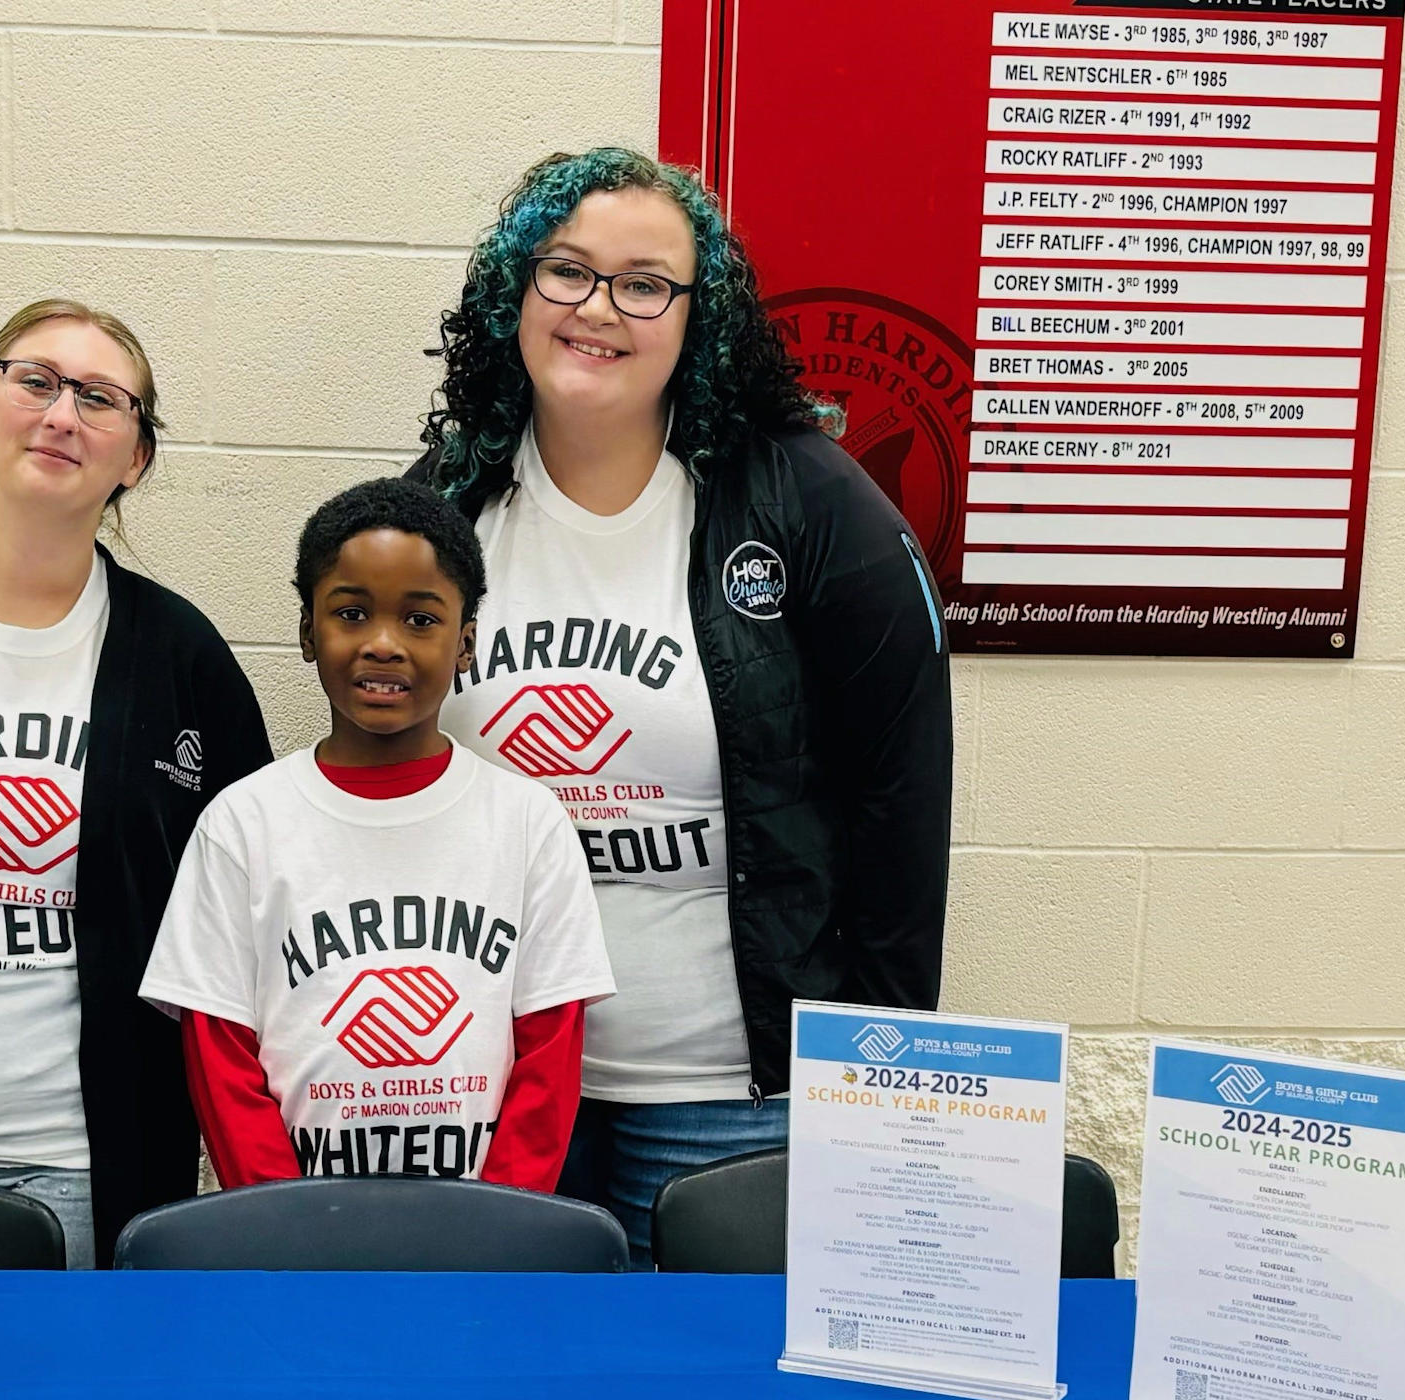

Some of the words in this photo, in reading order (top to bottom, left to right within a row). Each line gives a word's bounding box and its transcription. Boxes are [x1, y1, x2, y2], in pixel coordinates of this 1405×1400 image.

[1007, 21, 1049, 38] KYLE
[1055, 23, 1109, 40] MAYSE
[1124, 25, 1146, 41] 3RD
[1151, 26, 1189, 45] 1985,
[1195, 27, 1217, 43] 3RD
[1223, 29, 1260, 48] 1986,
[1266, 30, 1288, 46] 3RD
[1293, 31, 1327, 48] 1987
[1005, 64, 1038, 80] MEL
[1043, 65, 1151, 84] RENTSCHLER
[1166, 68, 1187, 85] 6TH
[1193, 70, 1226, 86] 1985
[1003, 106, 1053, 123] CRAIG
[1059, 108, 1105, 125] RIZER
[1120, 109, 1141, 125] 4TH
[1147, 111, 1184, 130] 1991,
[1189, 111, 1211, 127] 4TH
[1216, 113, 1250, 129] 1992
[1001, 148, 1058, 165] ROCKY
[1063, 150, 1127, 167] RATLIFF
[1141, 152, 1163, 168] 2ND
[1168, 154, 1202, 170] 1993
[998, 191, 1023, 207] J.P.
[1029, 191, 1078, 208] FELTY
[1091, 192, 1114, 208] 2ND
[1119, 194, 1156, 213] 1996,
[1162, 195, 1247, 213] CHAMPION
[1253, 198, 1287, 214] 1997
[996, 232, 1034, 248] JEFF
[1040, 233, 1104, 250] RATLIFF
[1118, 235, 1139, 251] 4TH
[1144, 236, 1181, 255] 1996,
[1188, 237, 1272, 254] CHAMPION
[1278, 239, 1315, 259] 1997,
[1321, 241, 1341, 259] 98,
[1346, 241, 1363, 257] 99
[994, 274, 1049, 291] COREY
[1054, 275, 1102, 292] SMITH
[1117, 277, 1139, 293] 3RD
[1144, 278, 1178, 294] 1999
[991, 316, 1025, 332] BILL
[1030, 317, 1109, 334] BEECHUM
[1124, 318, 1146, 334] 3RD
[1150, 319, 1183, 335] 2001
[989, 357, 1032, 373] BRET
[1036, 358, 1103, 374] THOMAS
[1126, 360, 1148, 376] 3RD
[1152, 360, 1187, 376] 2005
[987, 398, 1049, 414] CALLEN
[1054, 399, 1162, 416] VANDERHOFF
[1176, 401, 1196, 417] 8TH
[1200, 402, 1238, 421] 2008,
[1244, 403, 1265, 419] 5TH
[1269, 403, 1303, 419] 2009
[984, 439, 1038, 455] DRAKE
[1043, 440, 1098, 456] CERNY
[1111, 441, 1132, 457] 8TH
[1137, 442, 1170, 458] 2021
[732, 558, 778, 582] HOT
[944, 602, 978, 624] ding
[981, 603, 1019, 625] High
[1021, 604, 1074, 622] School
[1075, 604, 1114, 622] from
[1116, 605, 1143, 623] the
[1146, 605, 1209, 628] Harding
[1213, 605, 1288, 628] Wrestling
[1289, 608, 1346, 626] Alumni
[613, 785, 665, 800] CLUB
[582, 807, 628, 820] COUNTY
[281, 895, 517, 990] HARDING
[914, 1038, 941, 1048] BOYS
[953, 1042, 982, 1052] GIRLS
[985, 1045, 1012, 1055] CLUB
[309, 1082, 355, 1101] BOYS
[363, 1081, 376, 1098] &
[382, 1078, 444, 1097] GIRLS
[864, 1067, 988, 1097] 2024-2025
[1276, 1081, 1303, 1092] BOYS
[1316, 1087, 1347, 1098] GIRLS
[1349, 1092, 1378, 1103] CLUB
[341, 1107, 357, 1119] OF
[361, 1104, 410, 1117] MARION
[414, 1101, 462, 1116] COUNTY
[807, 1086, 885, 1107] SCHOOL
[892, 1094, 940, 1113] YEAR
[948, 1100, 1047, 1123] PROGRAM
[1221, 1109, 1352, 1148] 2024-2025
[1159, 1126, 1241, 1153] SCHOOL
[1249, 1140, 1300, 1162] YEAR
[1262, 1229, 1297, 1239] LOCATION:
